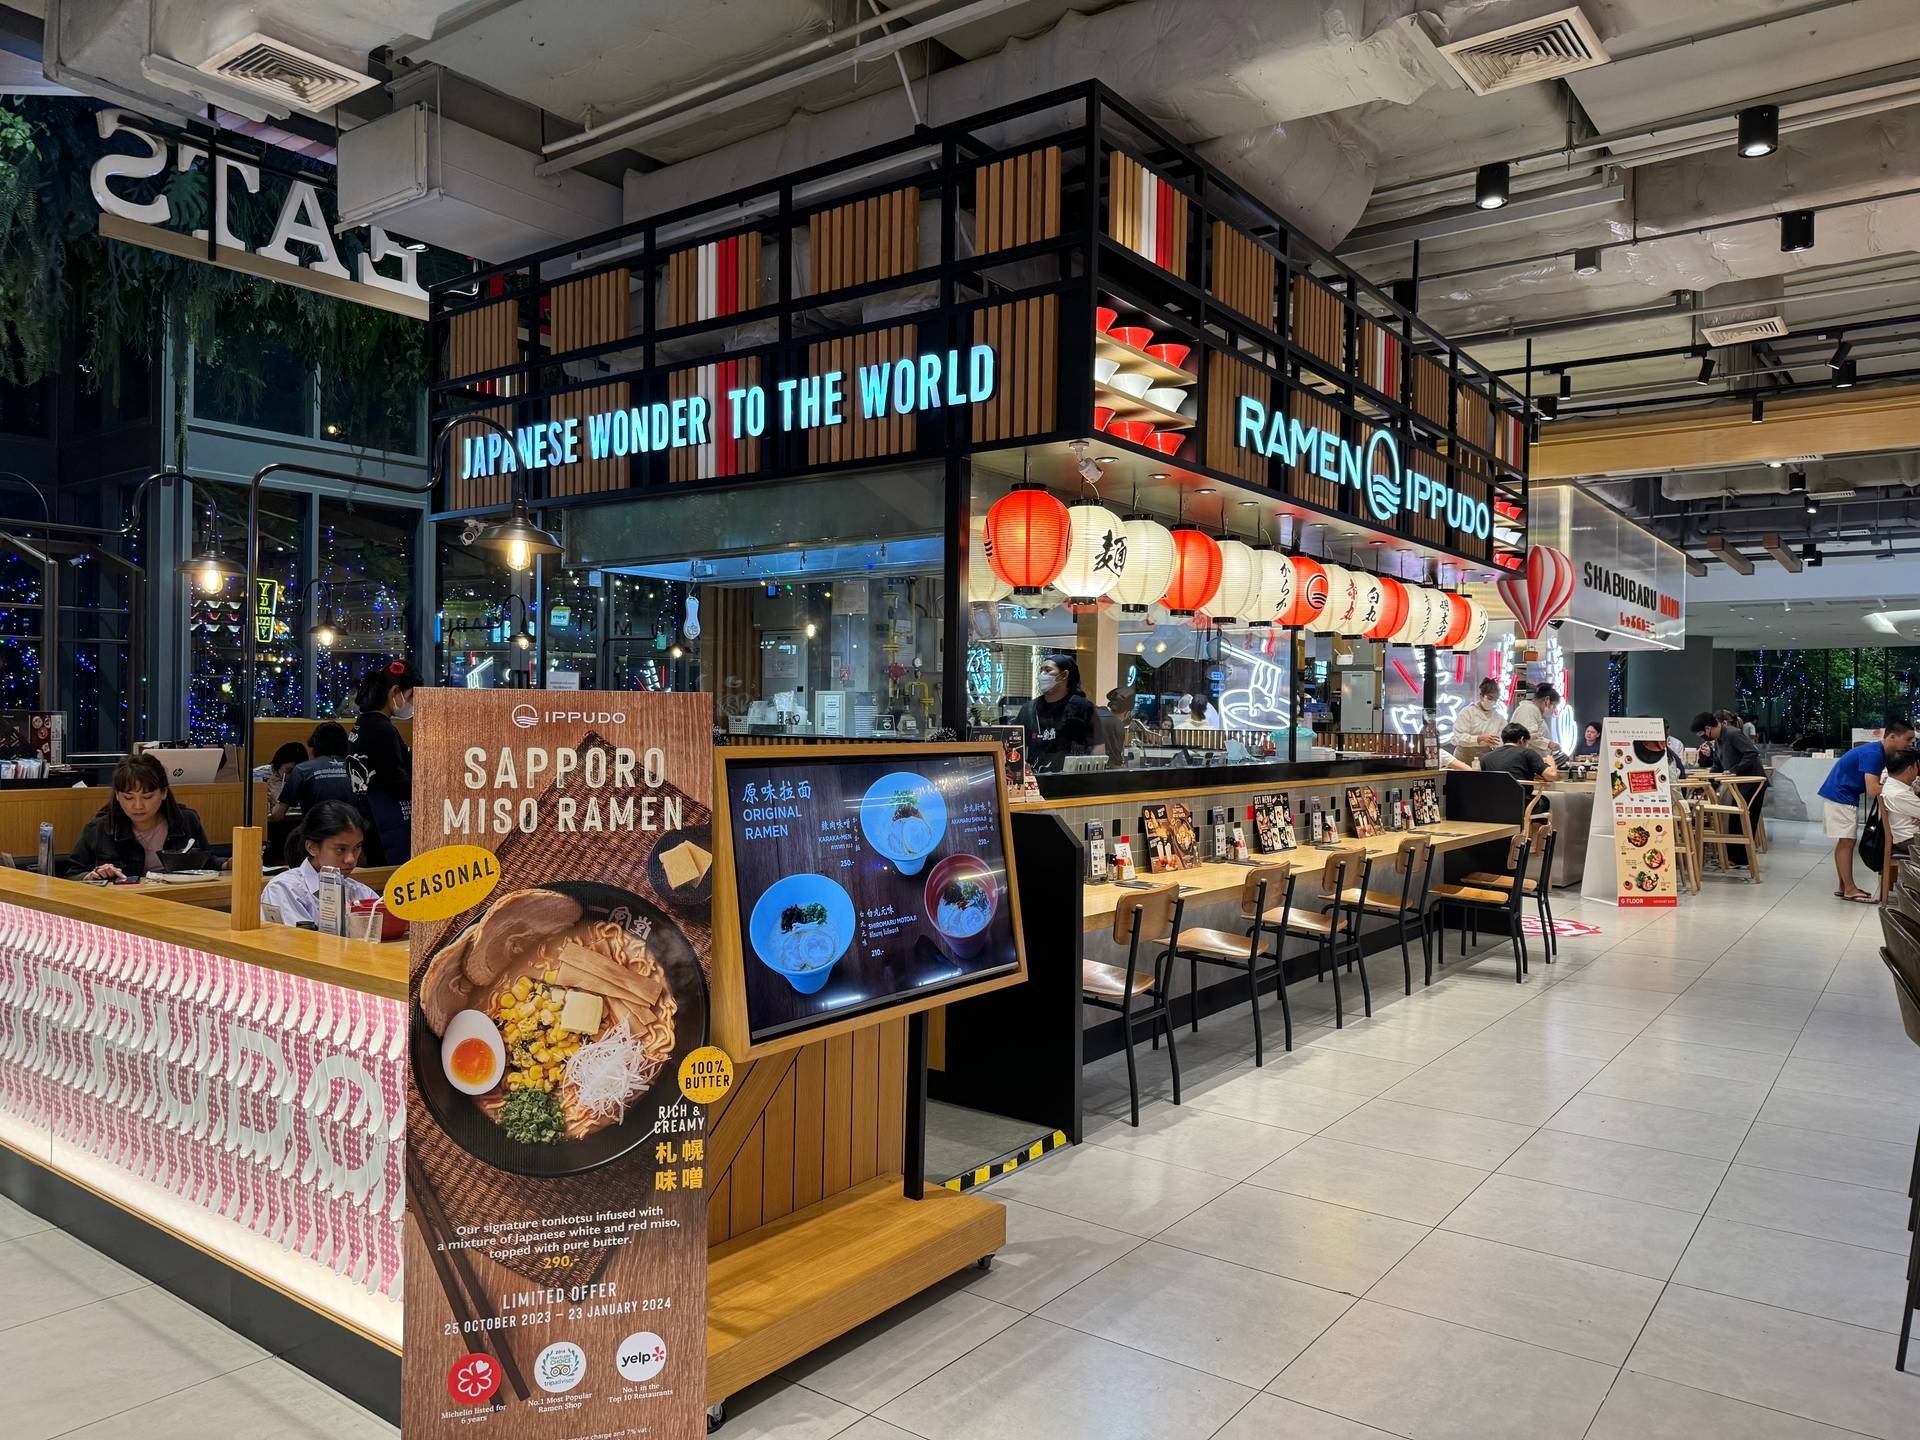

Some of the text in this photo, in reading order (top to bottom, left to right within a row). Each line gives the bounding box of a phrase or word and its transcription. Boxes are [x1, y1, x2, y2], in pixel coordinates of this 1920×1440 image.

[462, 345, 995, 480] JAPANESE WONDER TO THE WORLD
[1238, 395, 1490, 540] RAMEN IPPUDO
[1584, 561, 1657, 611] SHABUBARU
[1362, 587, 1381, 623] 白丸
[545, 712, 626, 724] IPPUDO
[464, 747, 665, 789] SAPPORO
[741, 780, 811, 804] 原味拉面
[443, 798, 539, 835] MISO
[558, 796, 683, 832] RAMEN
[743, 805, 802, 821] ORIGINAL
[745, 824, 789, 840] RAMEN
[393, 857, 495, 906] SEASONAL
[691, 1060, 725, 1075] 100%
[685, 1075, 730, 1089] BUTTER
[658, 1104, 700, 1119] RICH &
[654, 1117, 705, 1134] CREAMY
[655, 1139, 704, 1164] 札幌
[655, 1167, 703, 1191] 味噌
[456, 1206, 663, 1236] Our signature tonkotsu infused with
[437, 1217, 681, 1251] a mixture of Japanese white and red miso,
[489, 1235, 632, 1261] topped with pure butter.
[503, 1281, 617, 1310] LIMITED OFFER
[444, 1323, 459, 1336] 25
[464, 1315, 517, 1333] OCTOBER
[521, 1311, 551, 1326] 2023
[568, 1307, 582, 1320] 23
[587, 1300, 638, 1318] JANUARY
[642, 1297, 672, 1311] 2024
[621, 1350, 651, 1367] yelp
[528, 1391, 592, 1407] No.1 Most Popular
[608, 1388, 673, 1403] Top 10 Restaurants
[622, 1385, 639, 1394] No.1
[640, 1384, 647, 1392] in
[441, 1403, 507, 1420] Michelin listed for
[538, 1401, 582, 1413] Ramen Shop
[461, 1414, 487, 1425] 6 years
